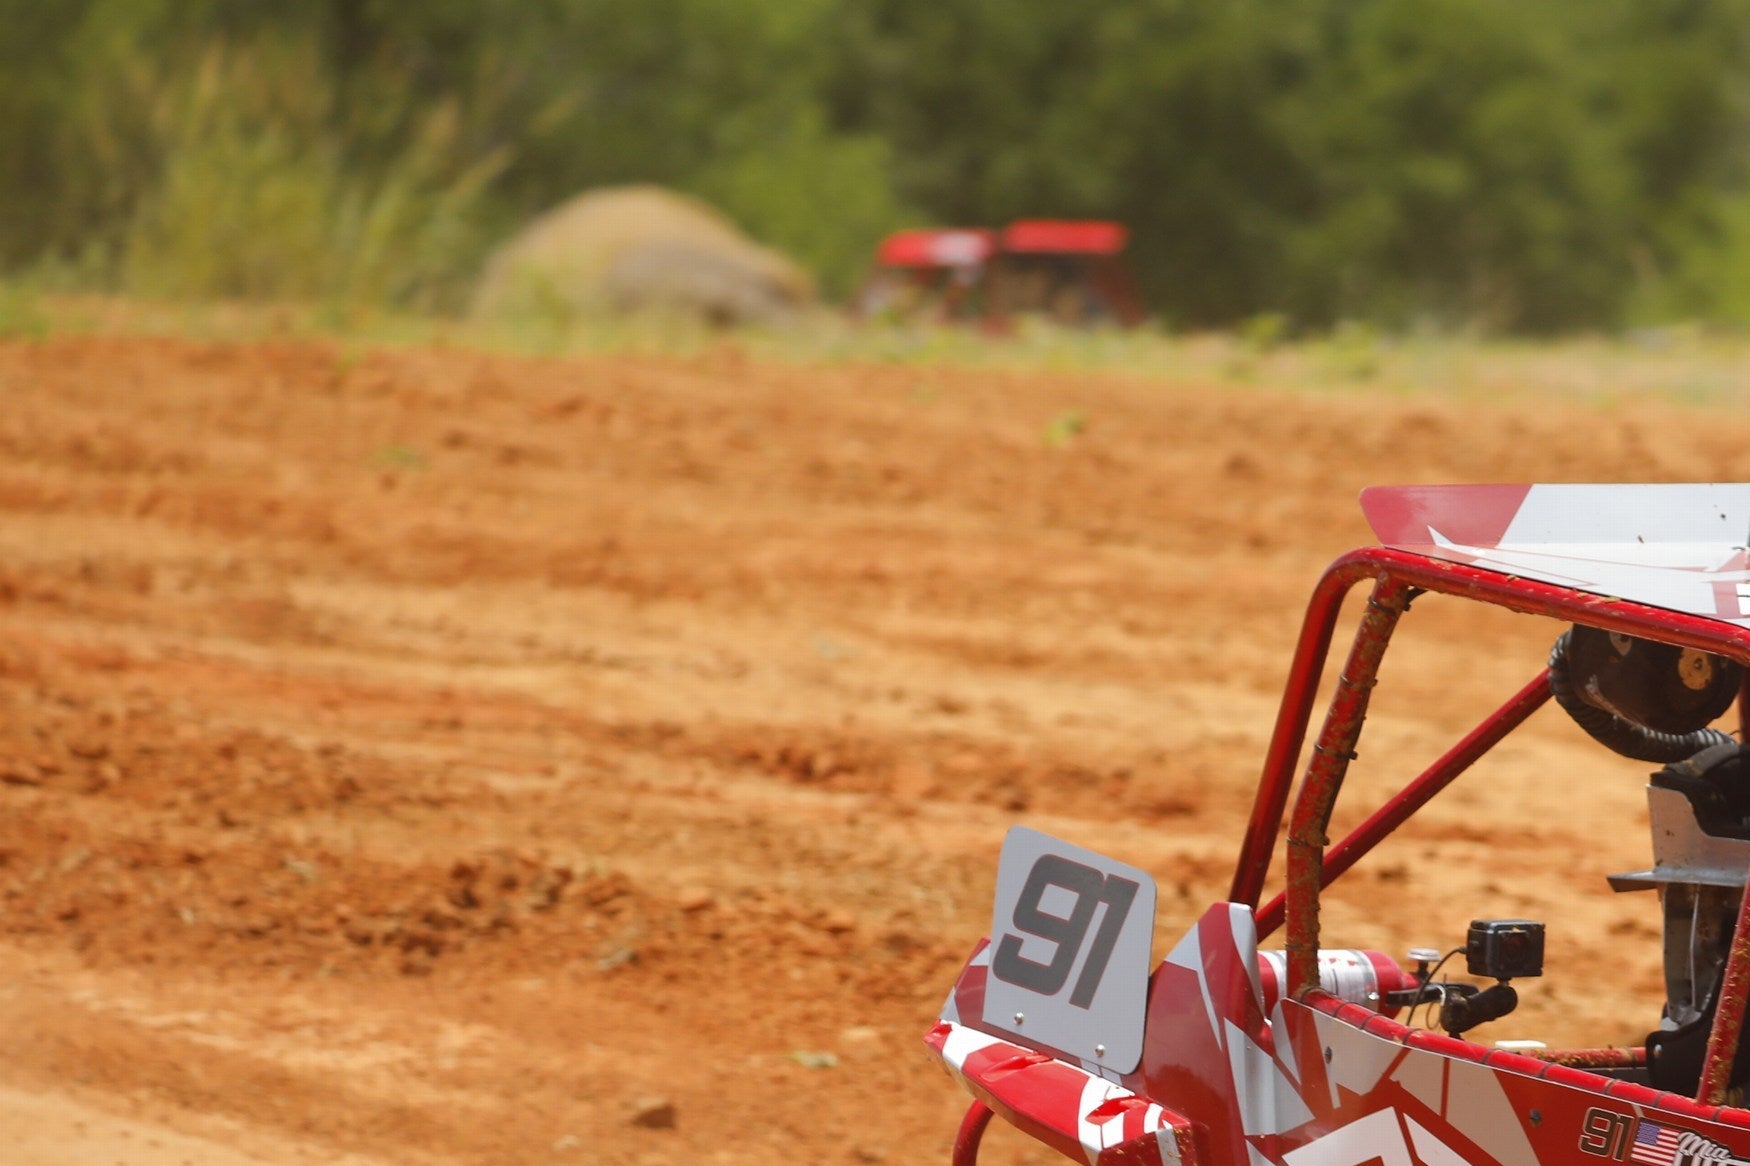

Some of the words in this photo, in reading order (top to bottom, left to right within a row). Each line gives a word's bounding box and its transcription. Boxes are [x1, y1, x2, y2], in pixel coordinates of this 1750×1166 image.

[993, 853, 1140, 1011] 91
[1578, 1106, 1635, 1162] 91
[1677, 1132, 1731, 1160] Mia
